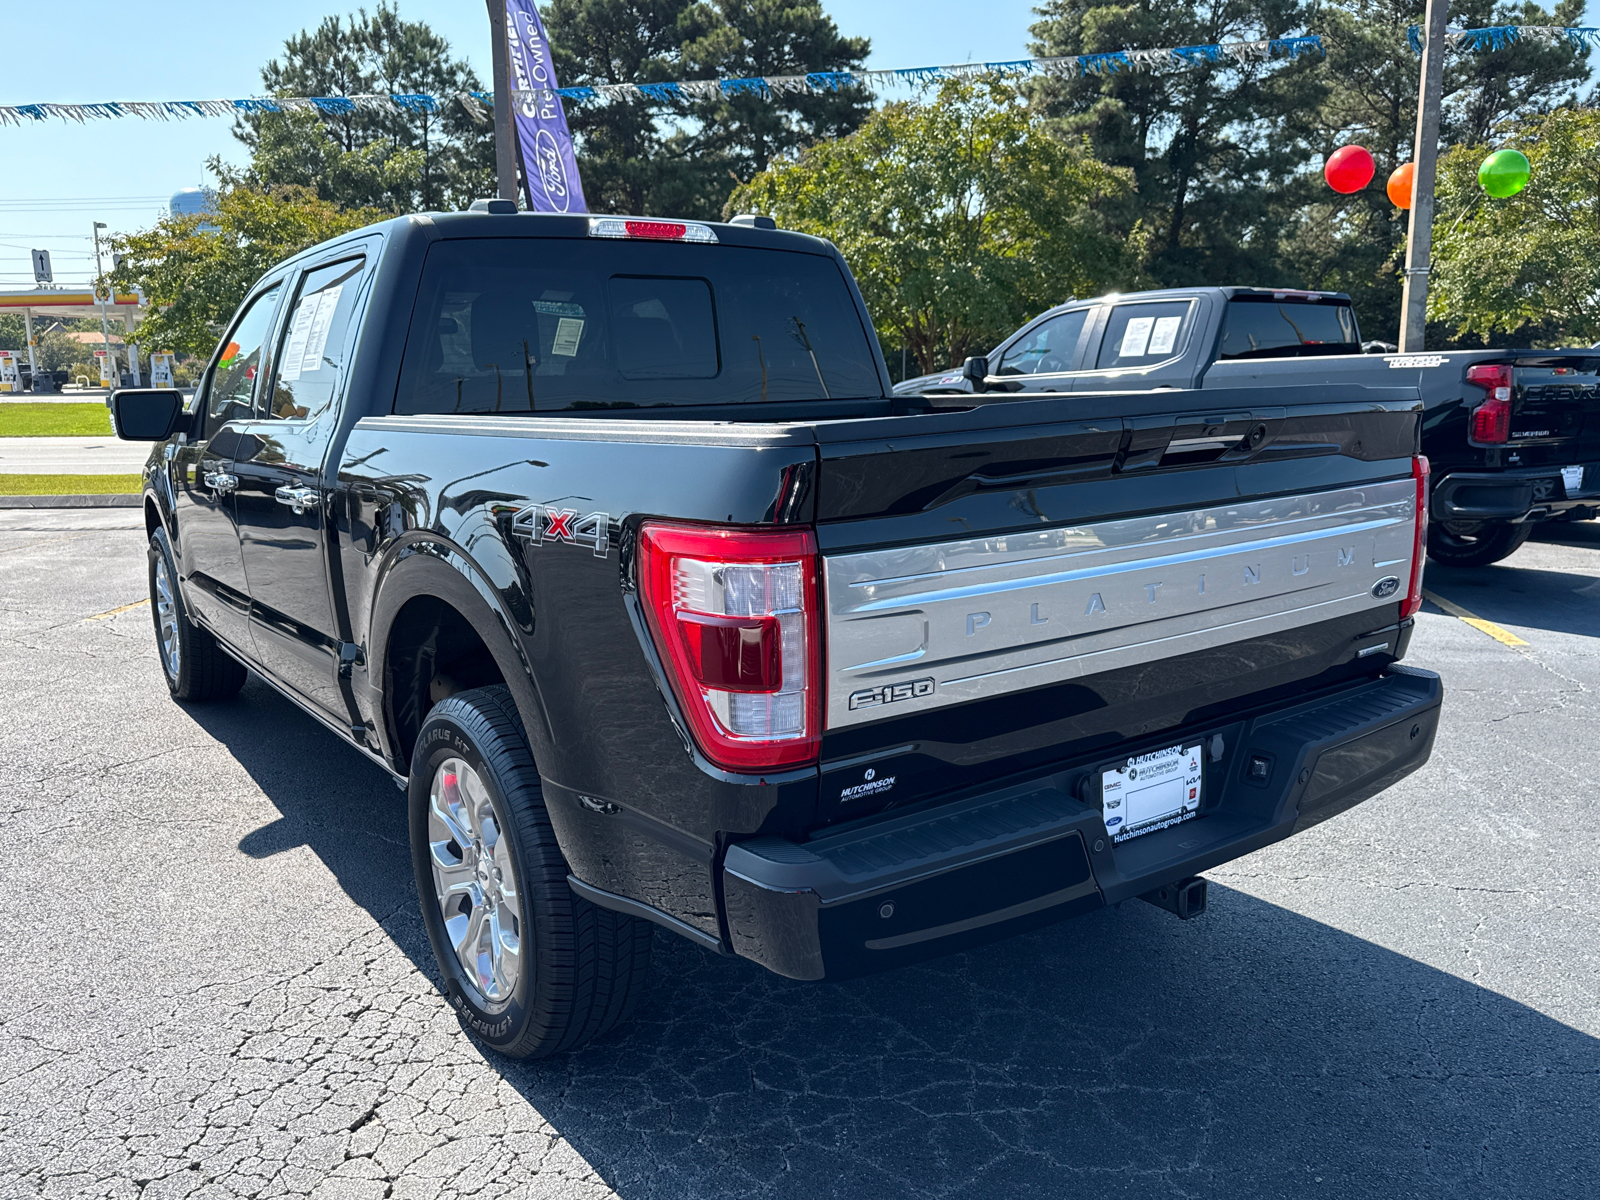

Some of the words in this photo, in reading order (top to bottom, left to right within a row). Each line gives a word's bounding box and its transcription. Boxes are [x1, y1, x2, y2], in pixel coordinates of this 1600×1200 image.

[518, 11, 557, 119] Pre-Owned
[541, 146, 566, 197] Ford
[966, 545, 1355, 637] PLATINUM
[1377, 579, 1397, 596] Ford
[848, 677, 936, 711] F-150
[415, 729, 451, 765] SOLARUS
[454, 736, 470, 754] HT
[1136, 744, 1183, 766] HUTCHINSON
[840, 776, 896, 798] HUTCHINSON
[1104, 781, 1121, 790] GMC
[1139, 771, 1165, 782] AUTOMOTIVE
[1165, 766, 1178, 775] GROUP
[840, 789, 874, 802] AUTOMOTIVE
[874, 784, 893, 794] GROUP
[1114, 810, 1196, 844] Hutchinsonautogroup.com
[454, 994, 508, 1038] STARFIRE
